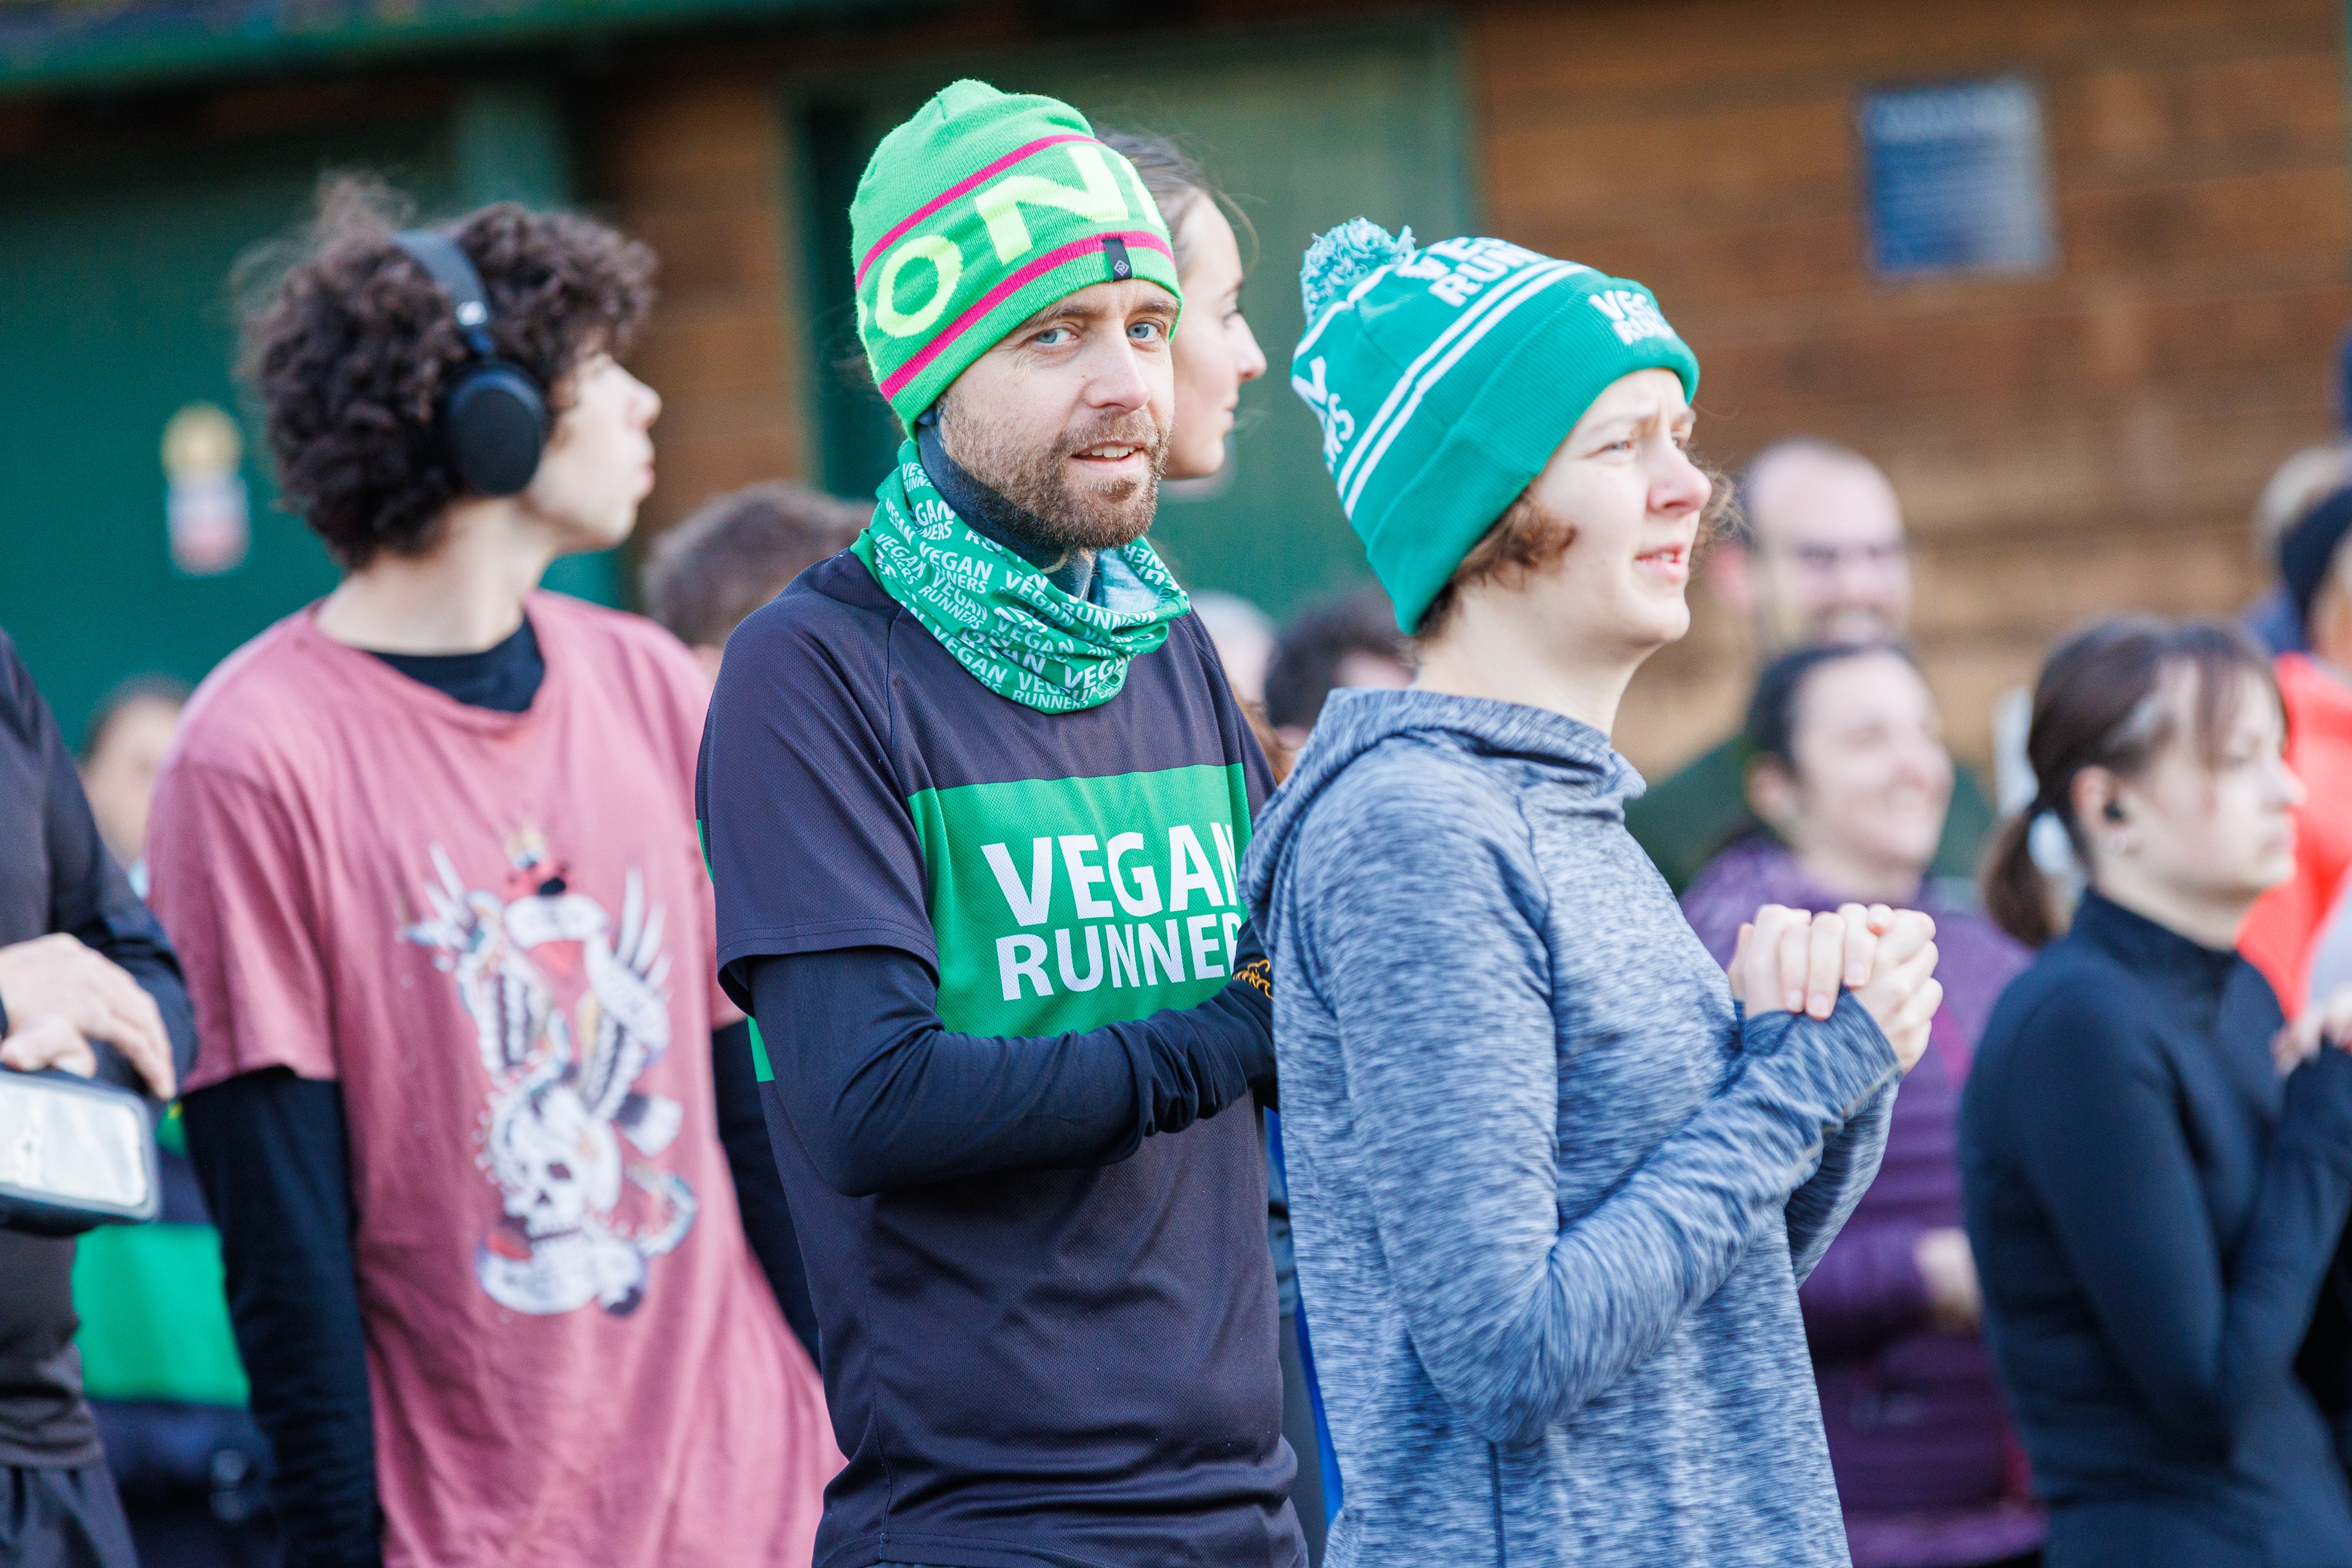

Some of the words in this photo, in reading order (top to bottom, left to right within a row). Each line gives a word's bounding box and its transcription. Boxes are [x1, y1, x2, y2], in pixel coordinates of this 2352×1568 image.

[904, 476, 934, 493] UNN
[913, 500, 957, 526] GAN
[916, 521, 954, 540] NERS
[876, 533, 927, 579] VEGAN
[920, 541, 994, 581] VEGAN
[932, 571, 988, 621] VEGAN
[934, 564, 988, 594] NERS
[1006, 570, 1075, 627] VEGAN
[918, 585, 984, 630] RUNNERS
[933, 625, 1008, 684] VEGAN
[998, 616, 1075, 654] VEGAN
[981, 821, 1238, 927] VEGAN
